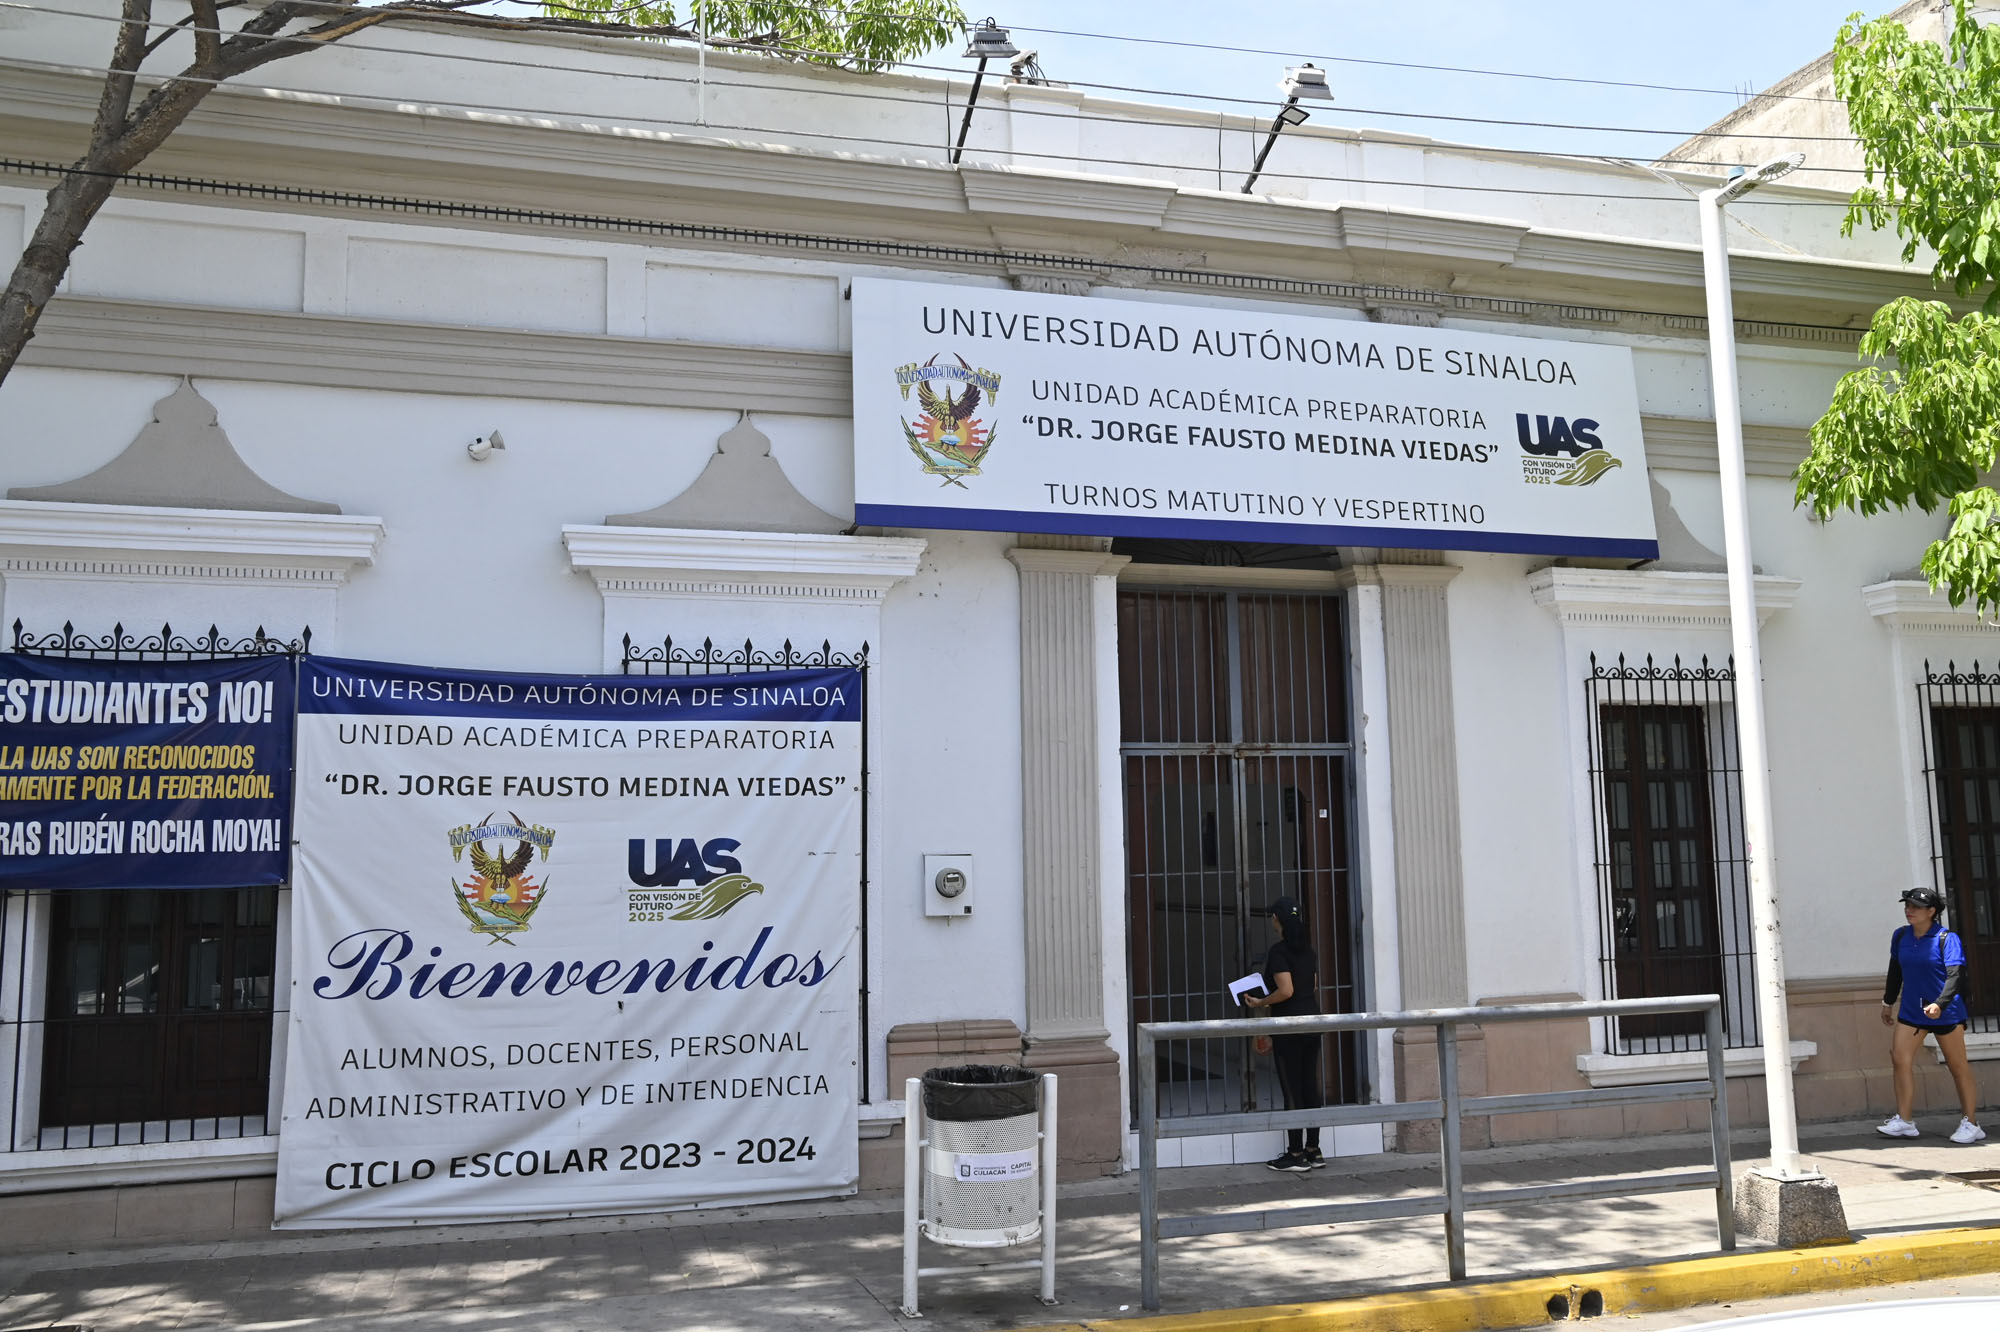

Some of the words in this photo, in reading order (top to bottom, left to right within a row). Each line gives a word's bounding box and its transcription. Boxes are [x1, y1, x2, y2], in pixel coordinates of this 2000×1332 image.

[924, 307, 1178, 353] UNIVERSIDAD
[1193, 328, 1384, 369] AUTÓNOMA
[1396, 346, 1434, 372] DE
[1445, 350, 1576, 385] SINALOA
[1033, 380, 1138, 405] UNIDAD
[1149, 389, 1298, 416] ACADÉMICA
[1308, 400, 1486, 429] PREPARATORIA
[1023, 415, 1081, 439] “DR.
[1092, 420, 1178, 444] JORGE
[1189, 426, 1285, 450] FAUSTO
[1295, 433, 1395, 457] MEDINA
[1401, 440, 1498, 463] VIEDAS”
[1516, 413, 1603, 457] UAS
[1523, 468, 1556, 476] FUTURO
[1524, 476, 1551, 485] 2025
[1540, 461, 1564, 469] VISIÓN
[1044, 484, 1157, 509] TURNOS
[1168, 490, 1303, 516] MATUTINO
[1312, 497, 1326, 516] Y
[1334, 498, 1484, 523] VESPERTINO
[219, 681, 273, 723] NO!
[314, 677, 513, 702] UNIVERSIDAD
[524, 683, 681, 705] AUTÓNOMA
[692, 689, 723, 706] DE
[733, 687, 845, 706] SINALOA
[340, 724, 452, 745] UNIDAD
[464, 724, 626, 748] ACADÉMICA
[639, 730, 834, 749] PREPARATORIA
[0, 746, 24, 769] LA
[31, 746, 73, 770] UAS
[77, 746, 119, 769] SON
[124, 745, 255, 770] RECONOCIDOS
[0, 776, 76, 800] MENTE
[82, 776, 122, 800] POR
[127, 776, 150, 799] LA
[157, 770, 274, 799] FEDERACIÓN.
[326, 774, 387, 795] “DR.
[398, 775, 492, 796] JORGE
[504, 776, 608, 797] FAUSTO
[620, 777, 729, 796] MEDINA
[738, 777, 845, 796] VIEDAS”
[49, 813, 125, 855] RUBÉN
[131, 820, 204, 853] ROCHA
[212, 819, 280, 852] MOYA!
[628, 838, 742, 887] UAS
[629, 902, 674, 911] FUTURO
[652, 892, 686, 900] VISIÓN
[628, 912, 664, 922] 2025
[313, 926, 845, 1000] Bienvenidos
[341, 1046, 494, 1070] ALUMNOS,
[508, 1039, 658, 1065] DOCENTES,
[671, 1032, 808, 1057] PERSONAL
[306, 1089, 565, 1119] ADMINISTRATIVO
[576, 1087, 591, 1106] Y
[602, 1084, 634, 1105] DE
[646, 1075, 828, 1103] INTENDENCIA
[326, 1159, 435, 1190] CICLO
[450, 1148, 607, 1178] ESCOLAR
[620, 1143, 701, 1170] 2023
[737, 1136, 816, 1164] 2024
